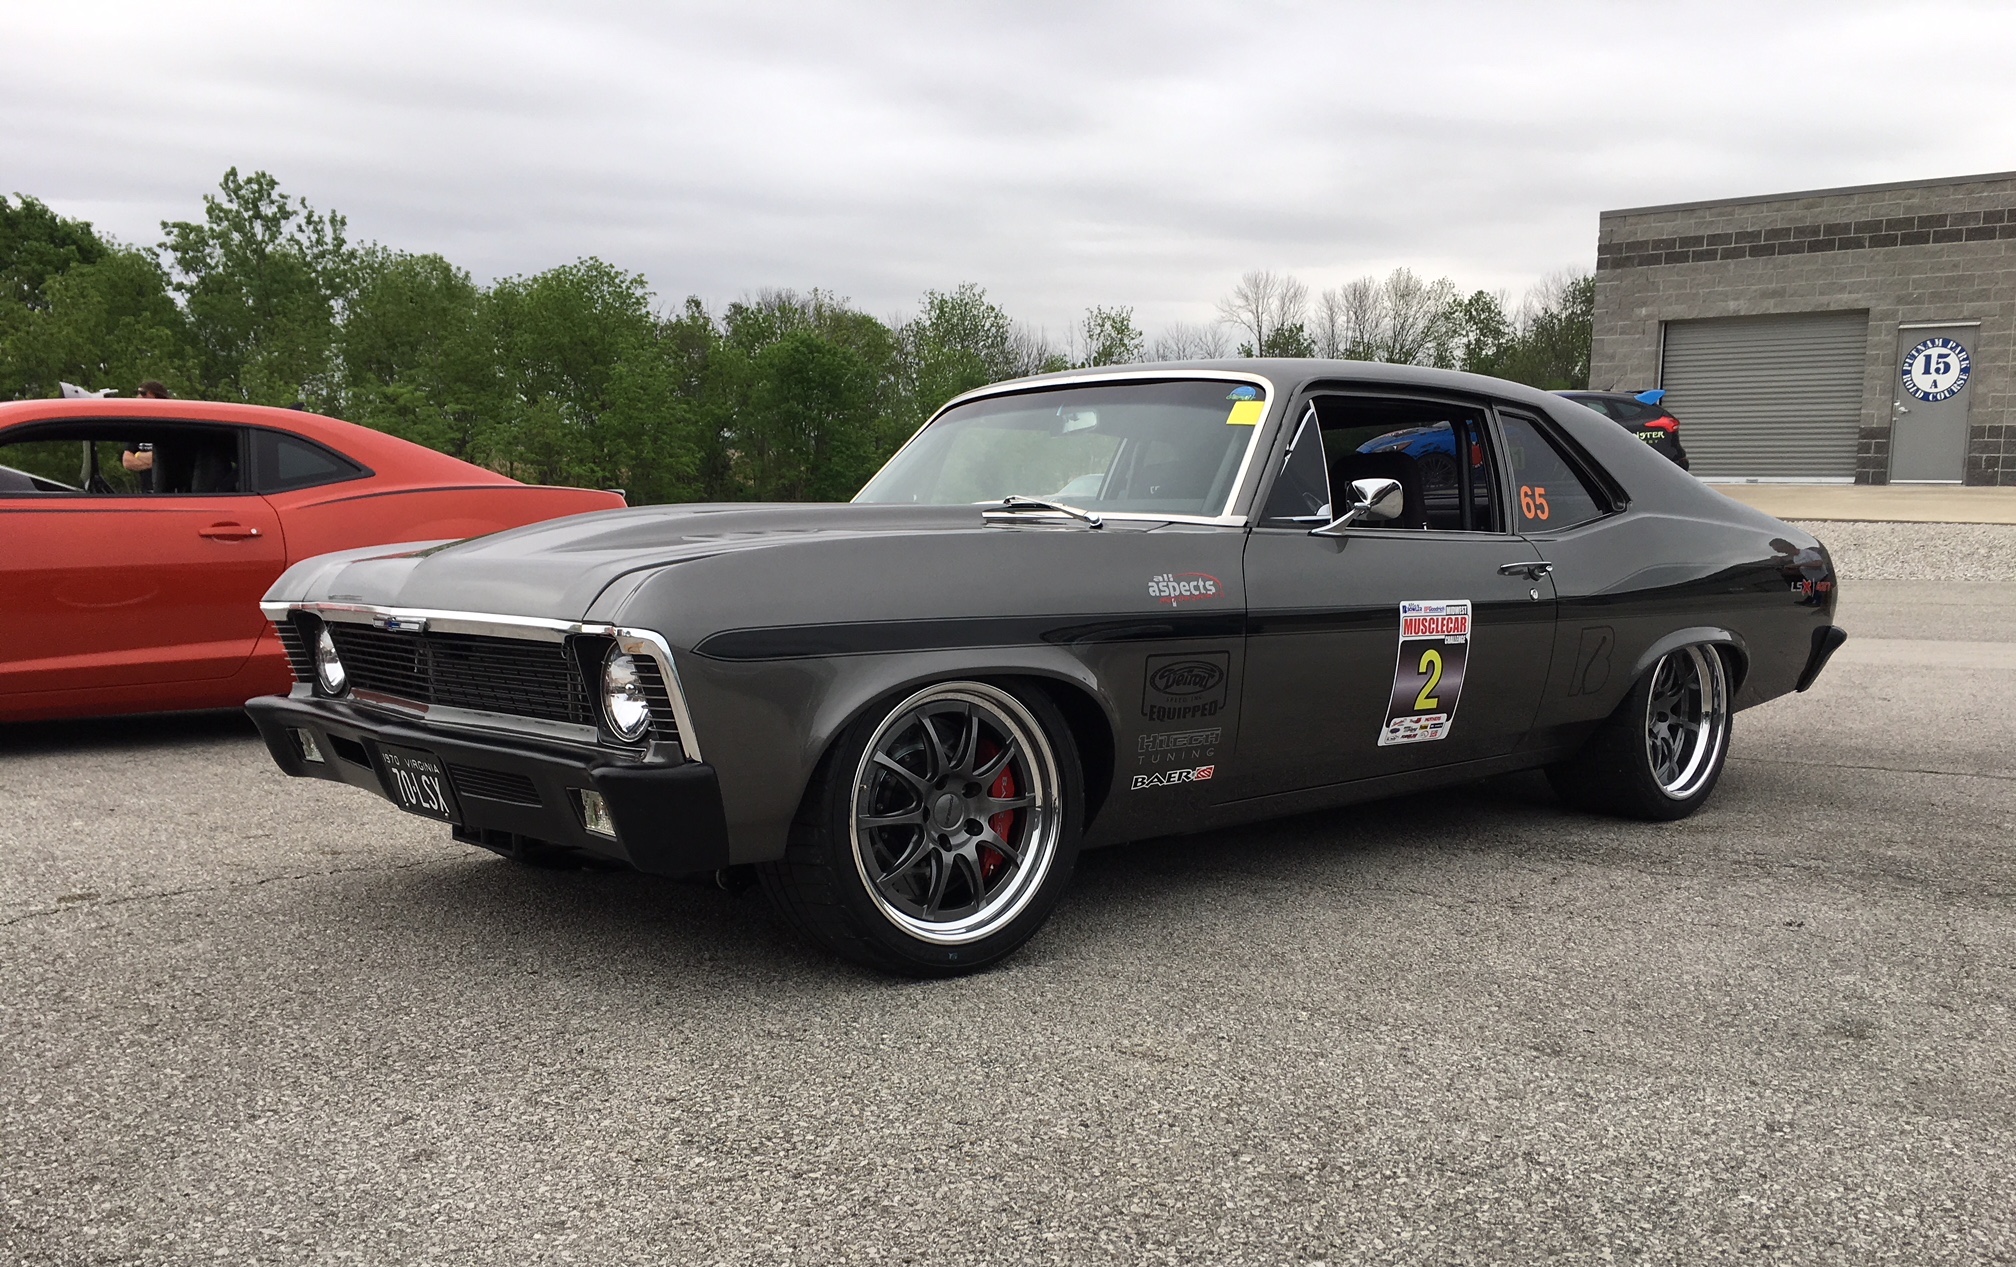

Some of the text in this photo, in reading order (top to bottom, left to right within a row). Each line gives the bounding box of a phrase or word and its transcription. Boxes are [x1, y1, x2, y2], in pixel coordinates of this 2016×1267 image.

[1902, 338, 1970, 371] PUTNAM PARK
[1921, 353, 1951, 375] 15
[1928, 371, 1969, 401] COURSE
[1929, 378, 1938, 390] A
[1520, 485, 1549, 520] 65
[1153, 573, 1174, 582] all
[1790, 578, 1812, 597] LSX
[1147, 577, 1216, 607] aspects
[1403, 616, 1467, 636] MUSCLECAR
[1414, 648, 1443, 711] 2
[1148, 700, 1219, 722] EQUIPPED
[382, 752, 440, 774] 1970 VIRGINIA
[1138, 747, 1215, 765] TUNING
[1130, 769, 1194, 791] BAER
